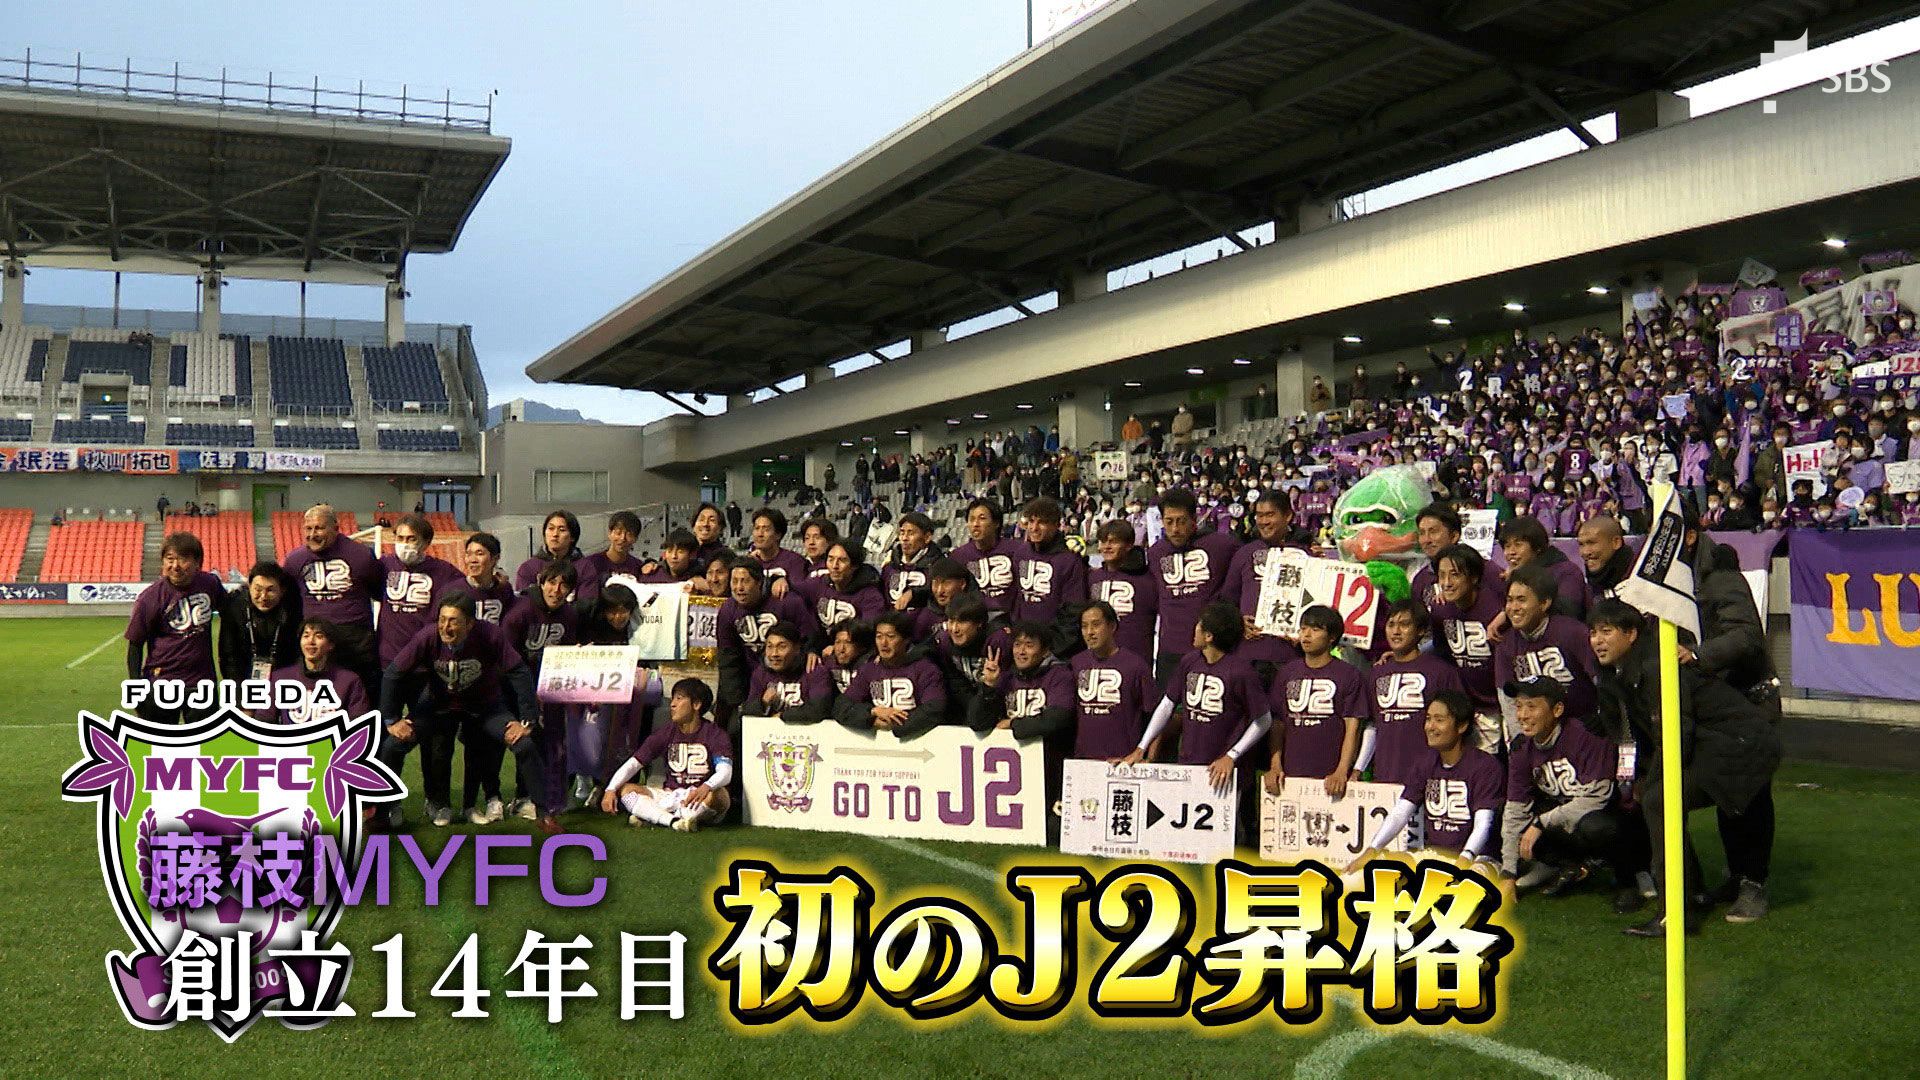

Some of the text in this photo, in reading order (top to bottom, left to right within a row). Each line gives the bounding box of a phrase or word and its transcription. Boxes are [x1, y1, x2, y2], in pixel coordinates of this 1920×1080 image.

[84, 450, 171, 470] 秋山拓也
[1570, 453, 1580, 469] 8
[303, 558, 350, 591] J2
[975, 555, 1013, 588] J2
[1019, 559, 1053, 594] J2
[1162, 549, 1210, 585] J2
[386, 571, 433, 604] J2
[1270, 563, 1302, 624] 藤枝
[168, 592, 213, 631] J2
[1447, 619, 1491, 657] J2
[590, 671, 623, 691] J2
[871, 677, 917, 711] J2
[1077, 668, 1122, 703] J2
[1186, 673, 1225, 714] J2
[1287, 678, 1337, 714] J2
[1376, 672, 1427, 709] J2
[1006, 688, 1047, 719] J2
[667, 743, 710, 775] J2
[833, 781, 921, 822] GO TO
[936, 745, 1024, 830] J2
[1425, 779, 1471, 825] J2
[1110, 789, 1134, 836] 藤枝
[1170, 802, 1214, 831] J2
[1281, 804, 1297, 847] 藤枝
